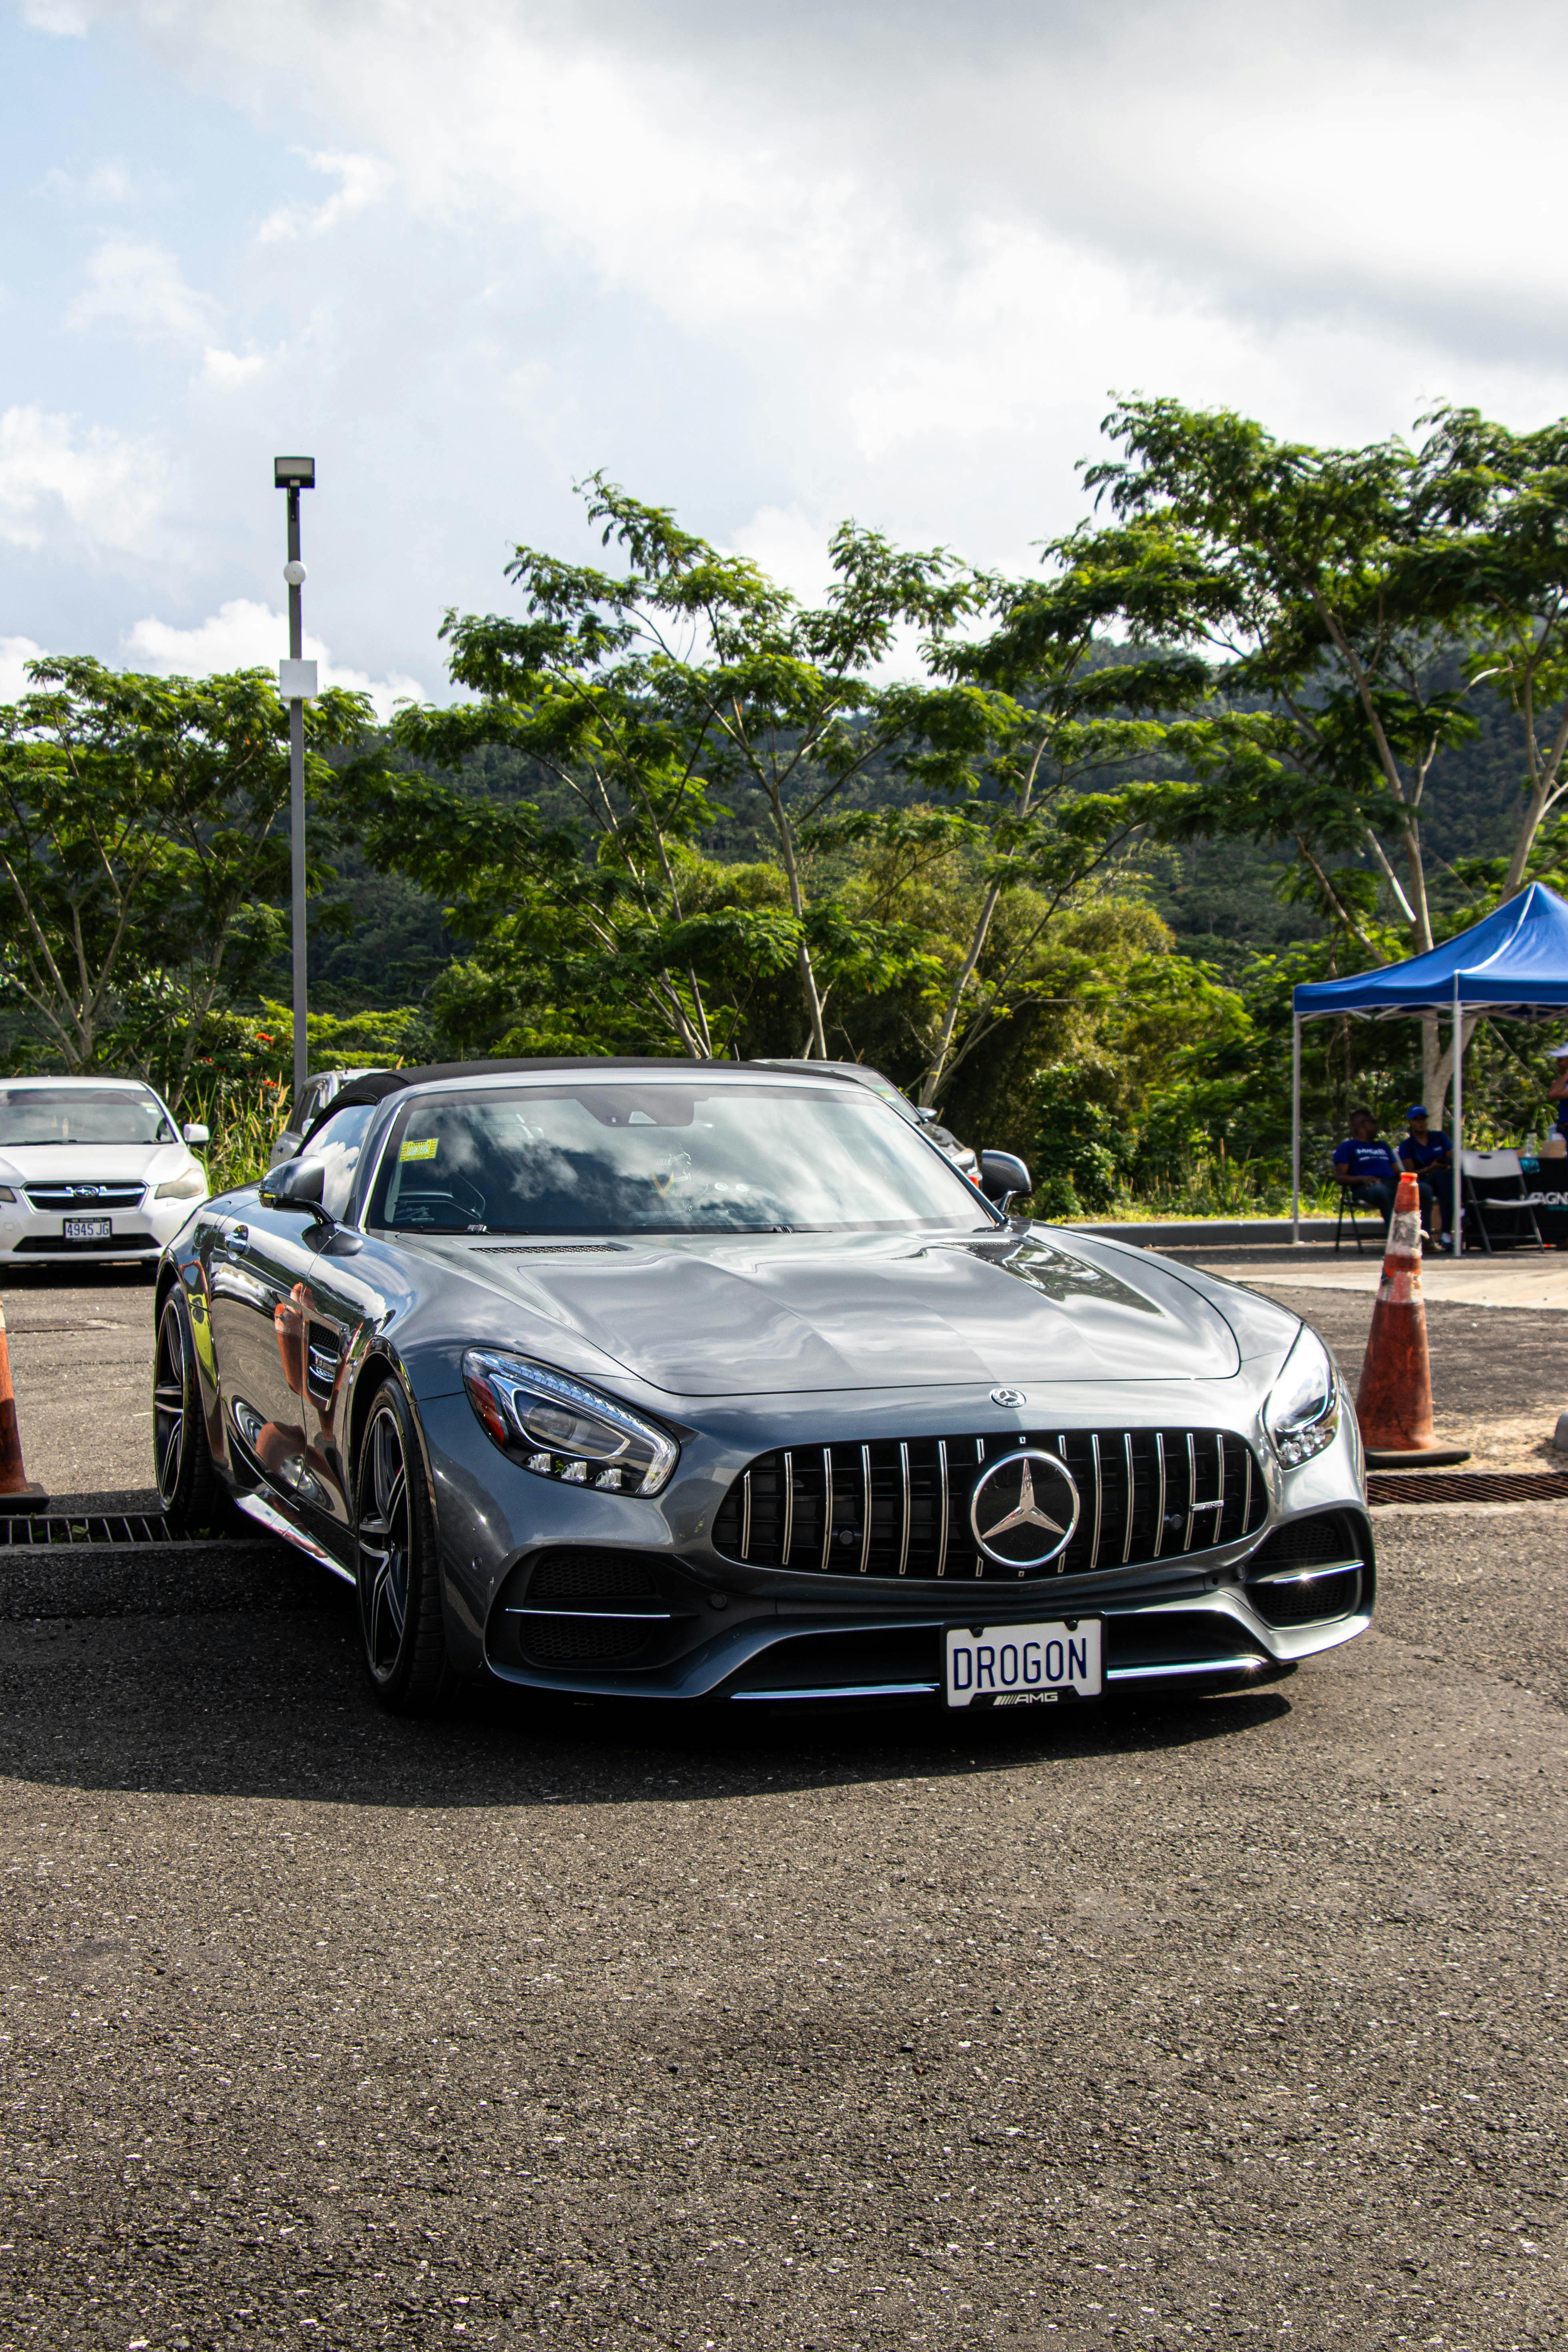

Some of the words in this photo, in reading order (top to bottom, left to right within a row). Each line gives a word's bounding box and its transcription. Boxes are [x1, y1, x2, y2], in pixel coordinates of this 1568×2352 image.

[407, 1145, 429, 1155] 25
[1520, 1191, 1568, 1205] AGN
[67, 1223, 94, 1236] 4945
[96, 1223, 109, 1235] JG
[953, 1638, 1087, 1690] DROGON
[1014, 1692, 1058, 1704] AMG
